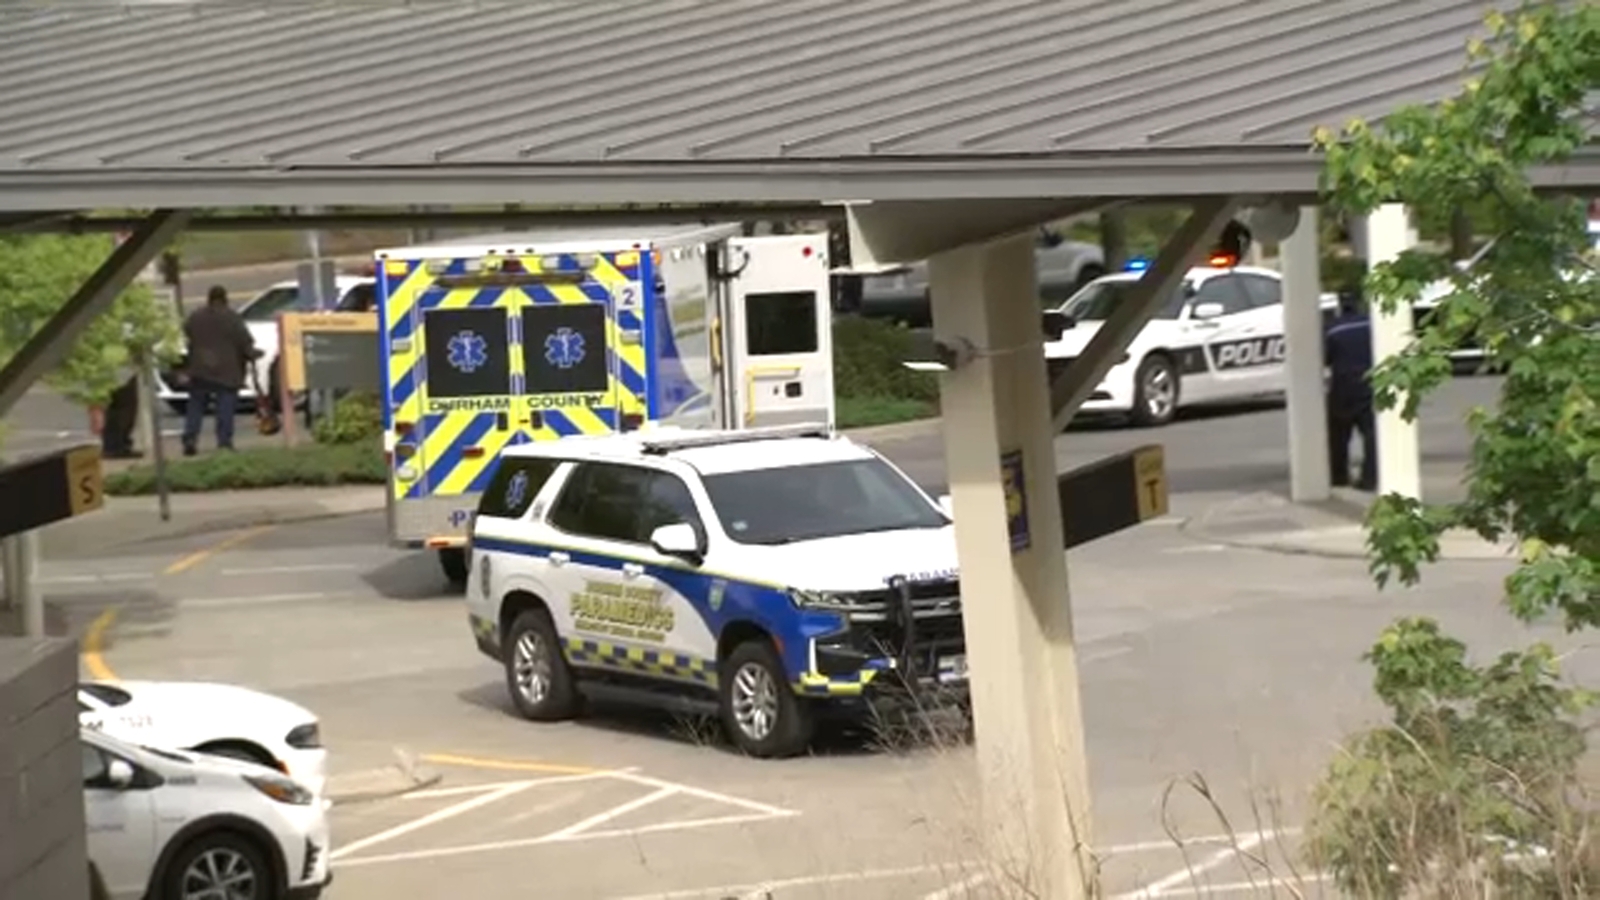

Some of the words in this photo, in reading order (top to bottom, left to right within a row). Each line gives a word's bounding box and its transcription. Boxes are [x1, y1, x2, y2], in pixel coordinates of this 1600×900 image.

[621, 287, 635, 306] 2
[429, 398, 511, 411] DURHAM
[526, 394, 603, 408] COUNTY
[79, 474, 95, 505] S
[1144, 478, 1159, 511] T
